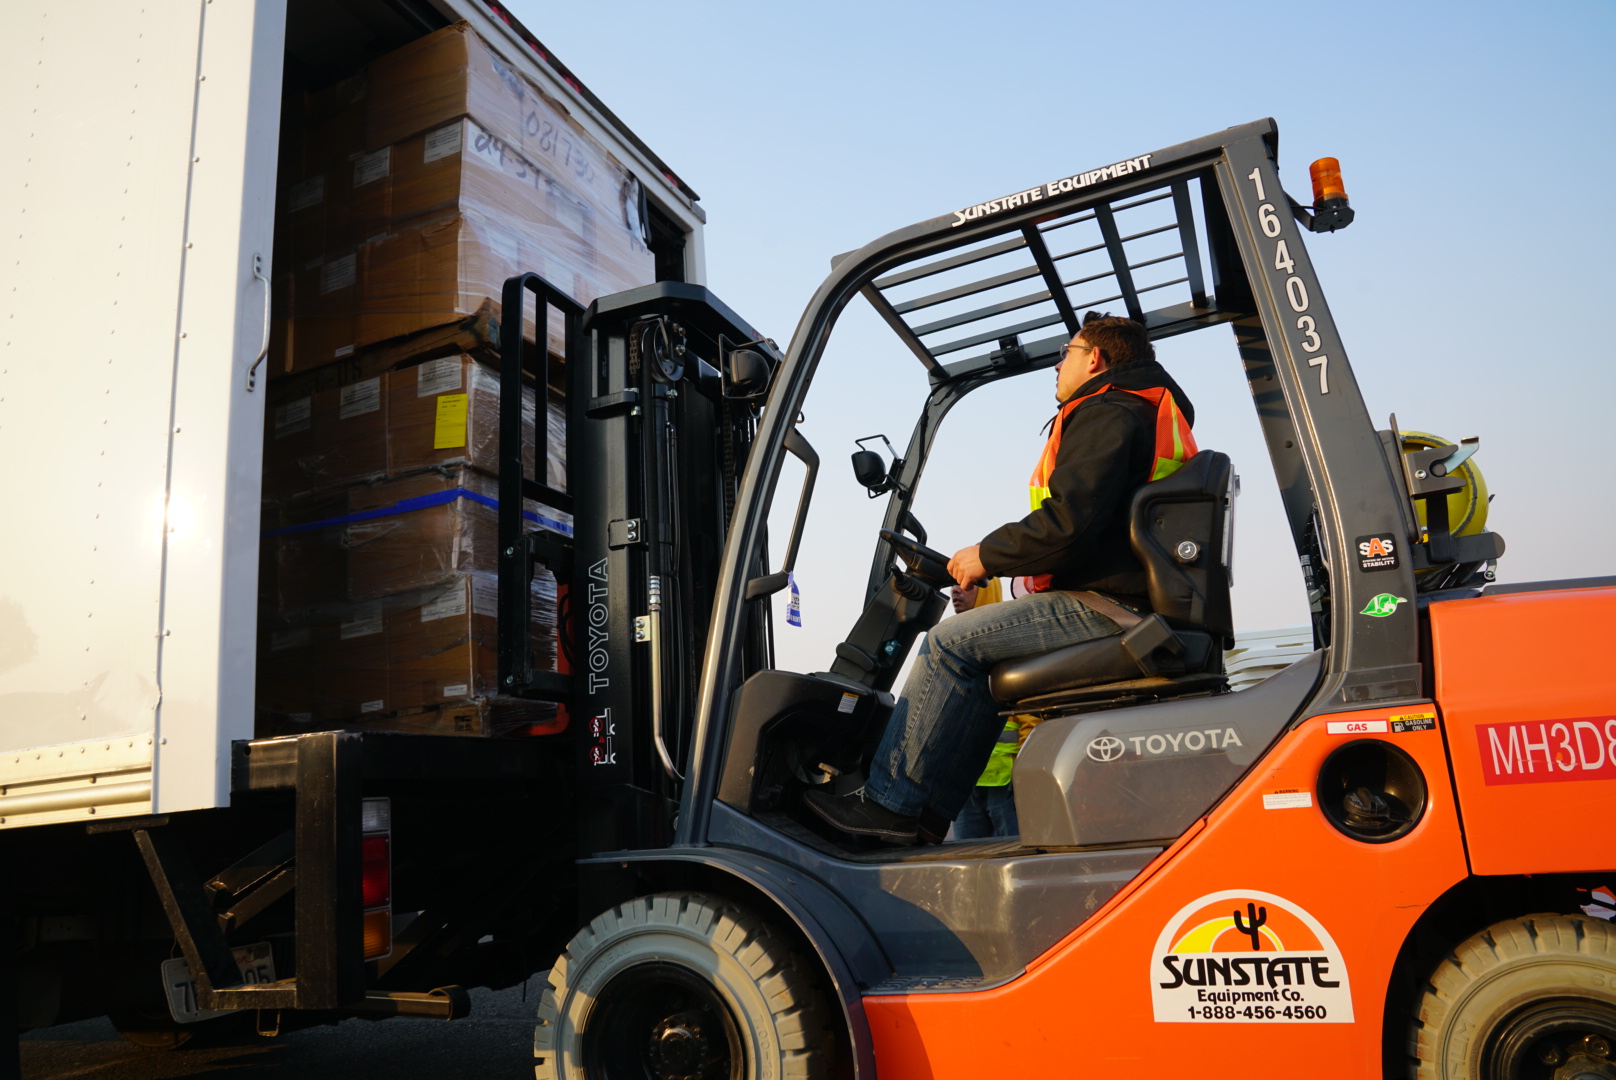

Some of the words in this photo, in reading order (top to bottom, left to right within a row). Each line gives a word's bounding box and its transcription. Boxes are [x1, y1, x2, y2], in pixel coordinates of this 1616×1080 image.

[951, 187, 1043, 227] SUNSTATE
[1047, 153, 1152, 197] EQUIPMENT
[1248, 167, 1329, 395] 164037
[1359, 538, 1394, 557] SAS
[589, 557, 609, 695] TOYOTA
[1129, 728, 1243, 755] TOYOTA
[1346, 723, 1368, 731] GAS
[1488, 719, 1616, 775] MH3D8
[1160, 955, 1340, 989] SUNSTATE
[1197, 988, 1280, 1005] Equipment
[1281, 988, 1305, 1002] Co.
[1187, 1005, 1327, 1020] 1-888-456-4560
